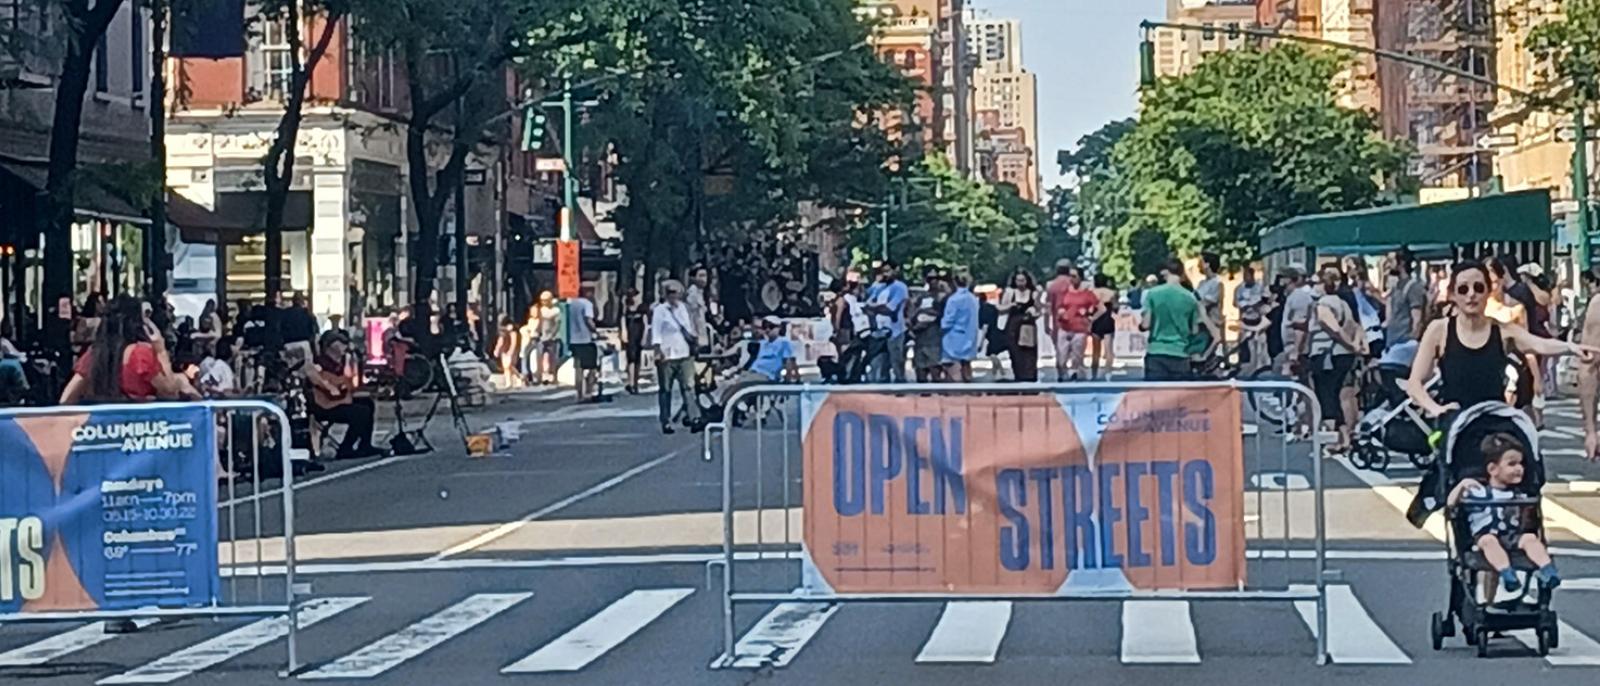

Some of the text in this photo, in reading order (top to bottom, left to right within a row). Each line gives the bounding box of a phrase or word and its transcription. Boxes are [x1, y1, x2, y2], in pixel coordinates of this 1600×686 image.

[71, 421, 168, 441] COLUMBUS
[121, 433, 193, 452] AVENUE
[832, 410, 967, 517] OPEN
[997, 458, 1217, 572] STREETS
